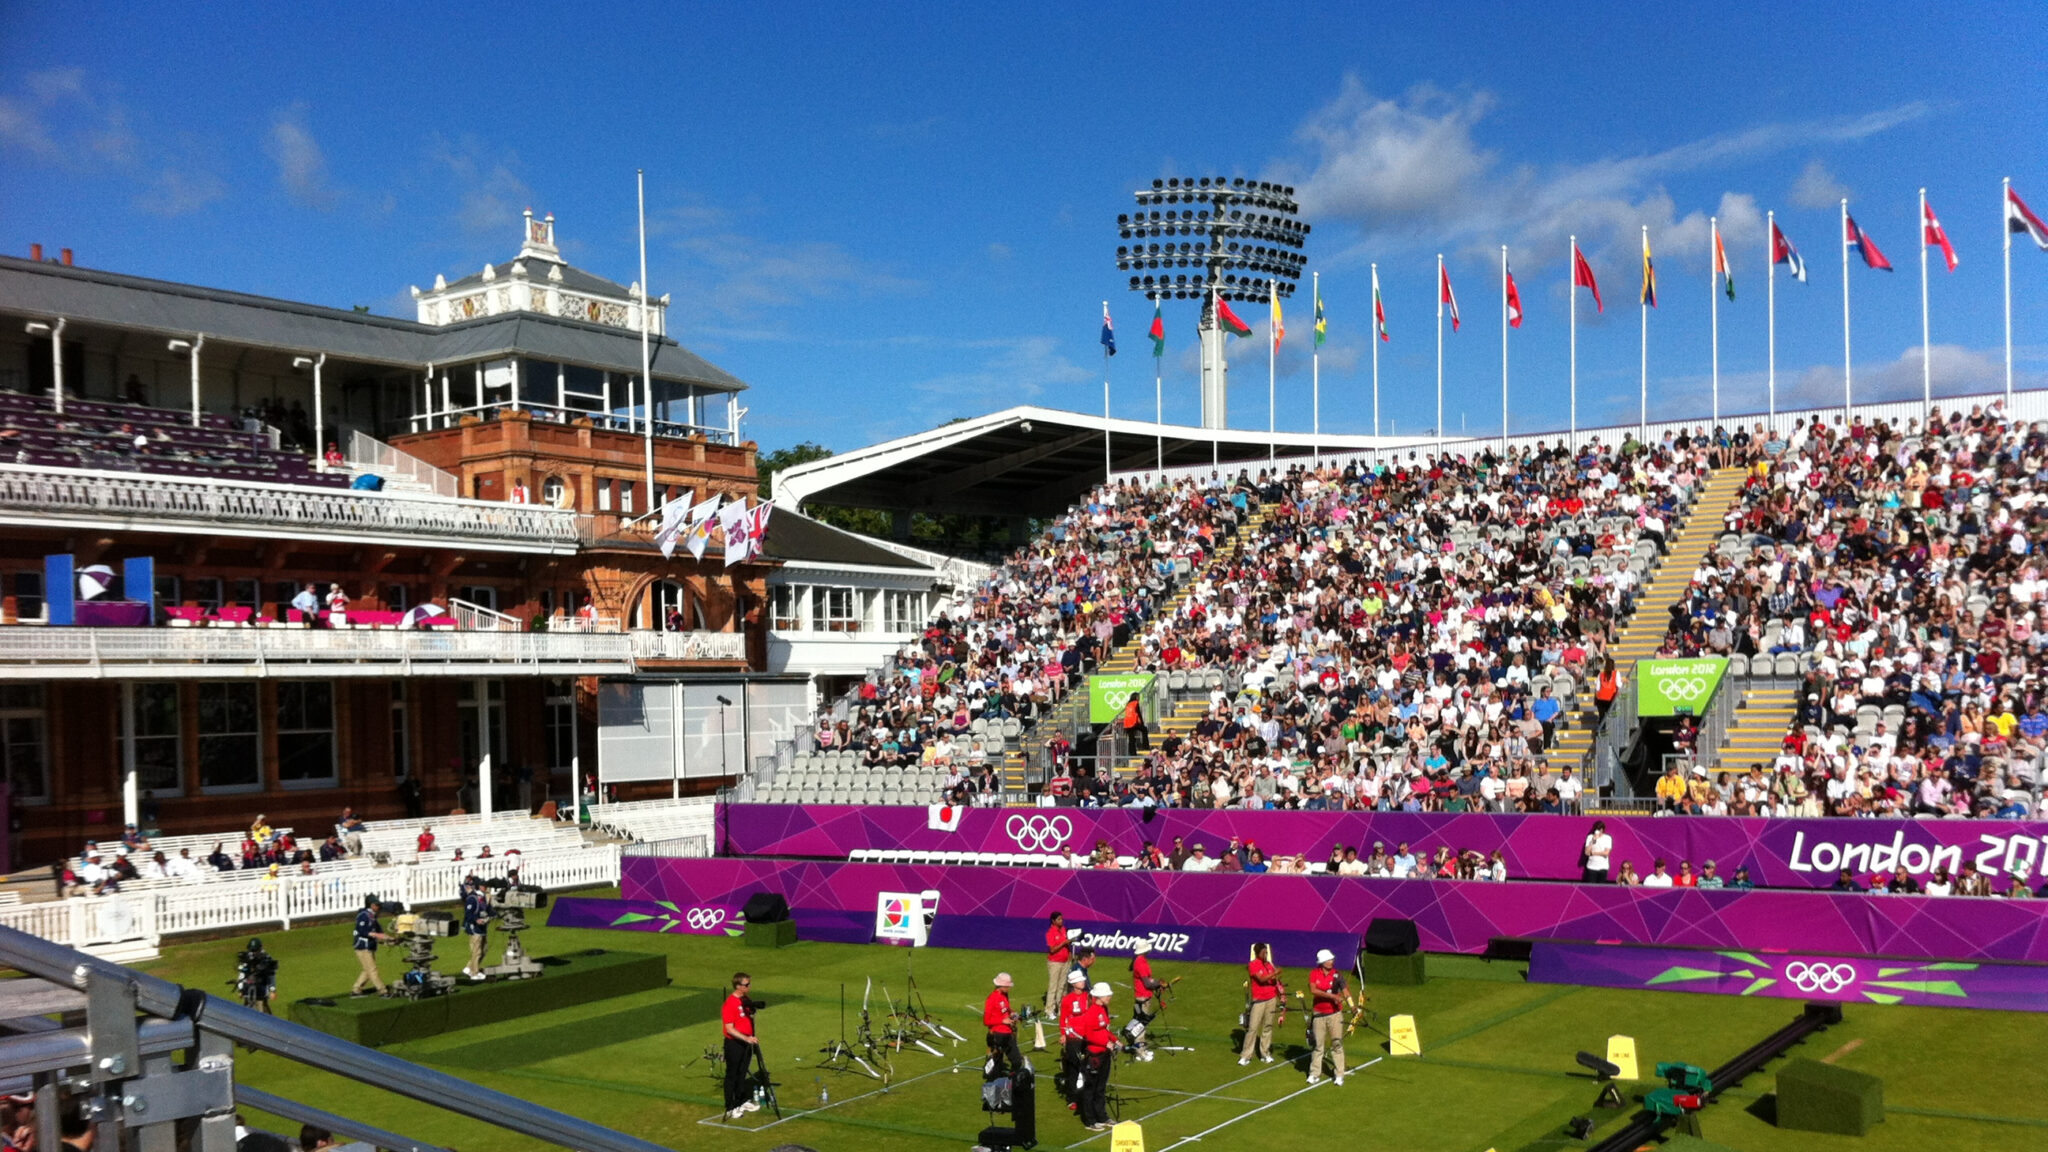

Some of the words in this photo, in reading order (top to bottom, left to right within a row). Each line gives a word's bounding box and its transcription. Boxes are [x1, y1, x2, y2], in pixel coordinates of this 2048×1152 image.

[1650, 663, 1689, 675] London
[1691, 663, 1717, 674] 2012
[1098, 678, 1127, 688] London
[1789, 830, 1962, 875] London
[1147, 932, 1190, 952] 2012
